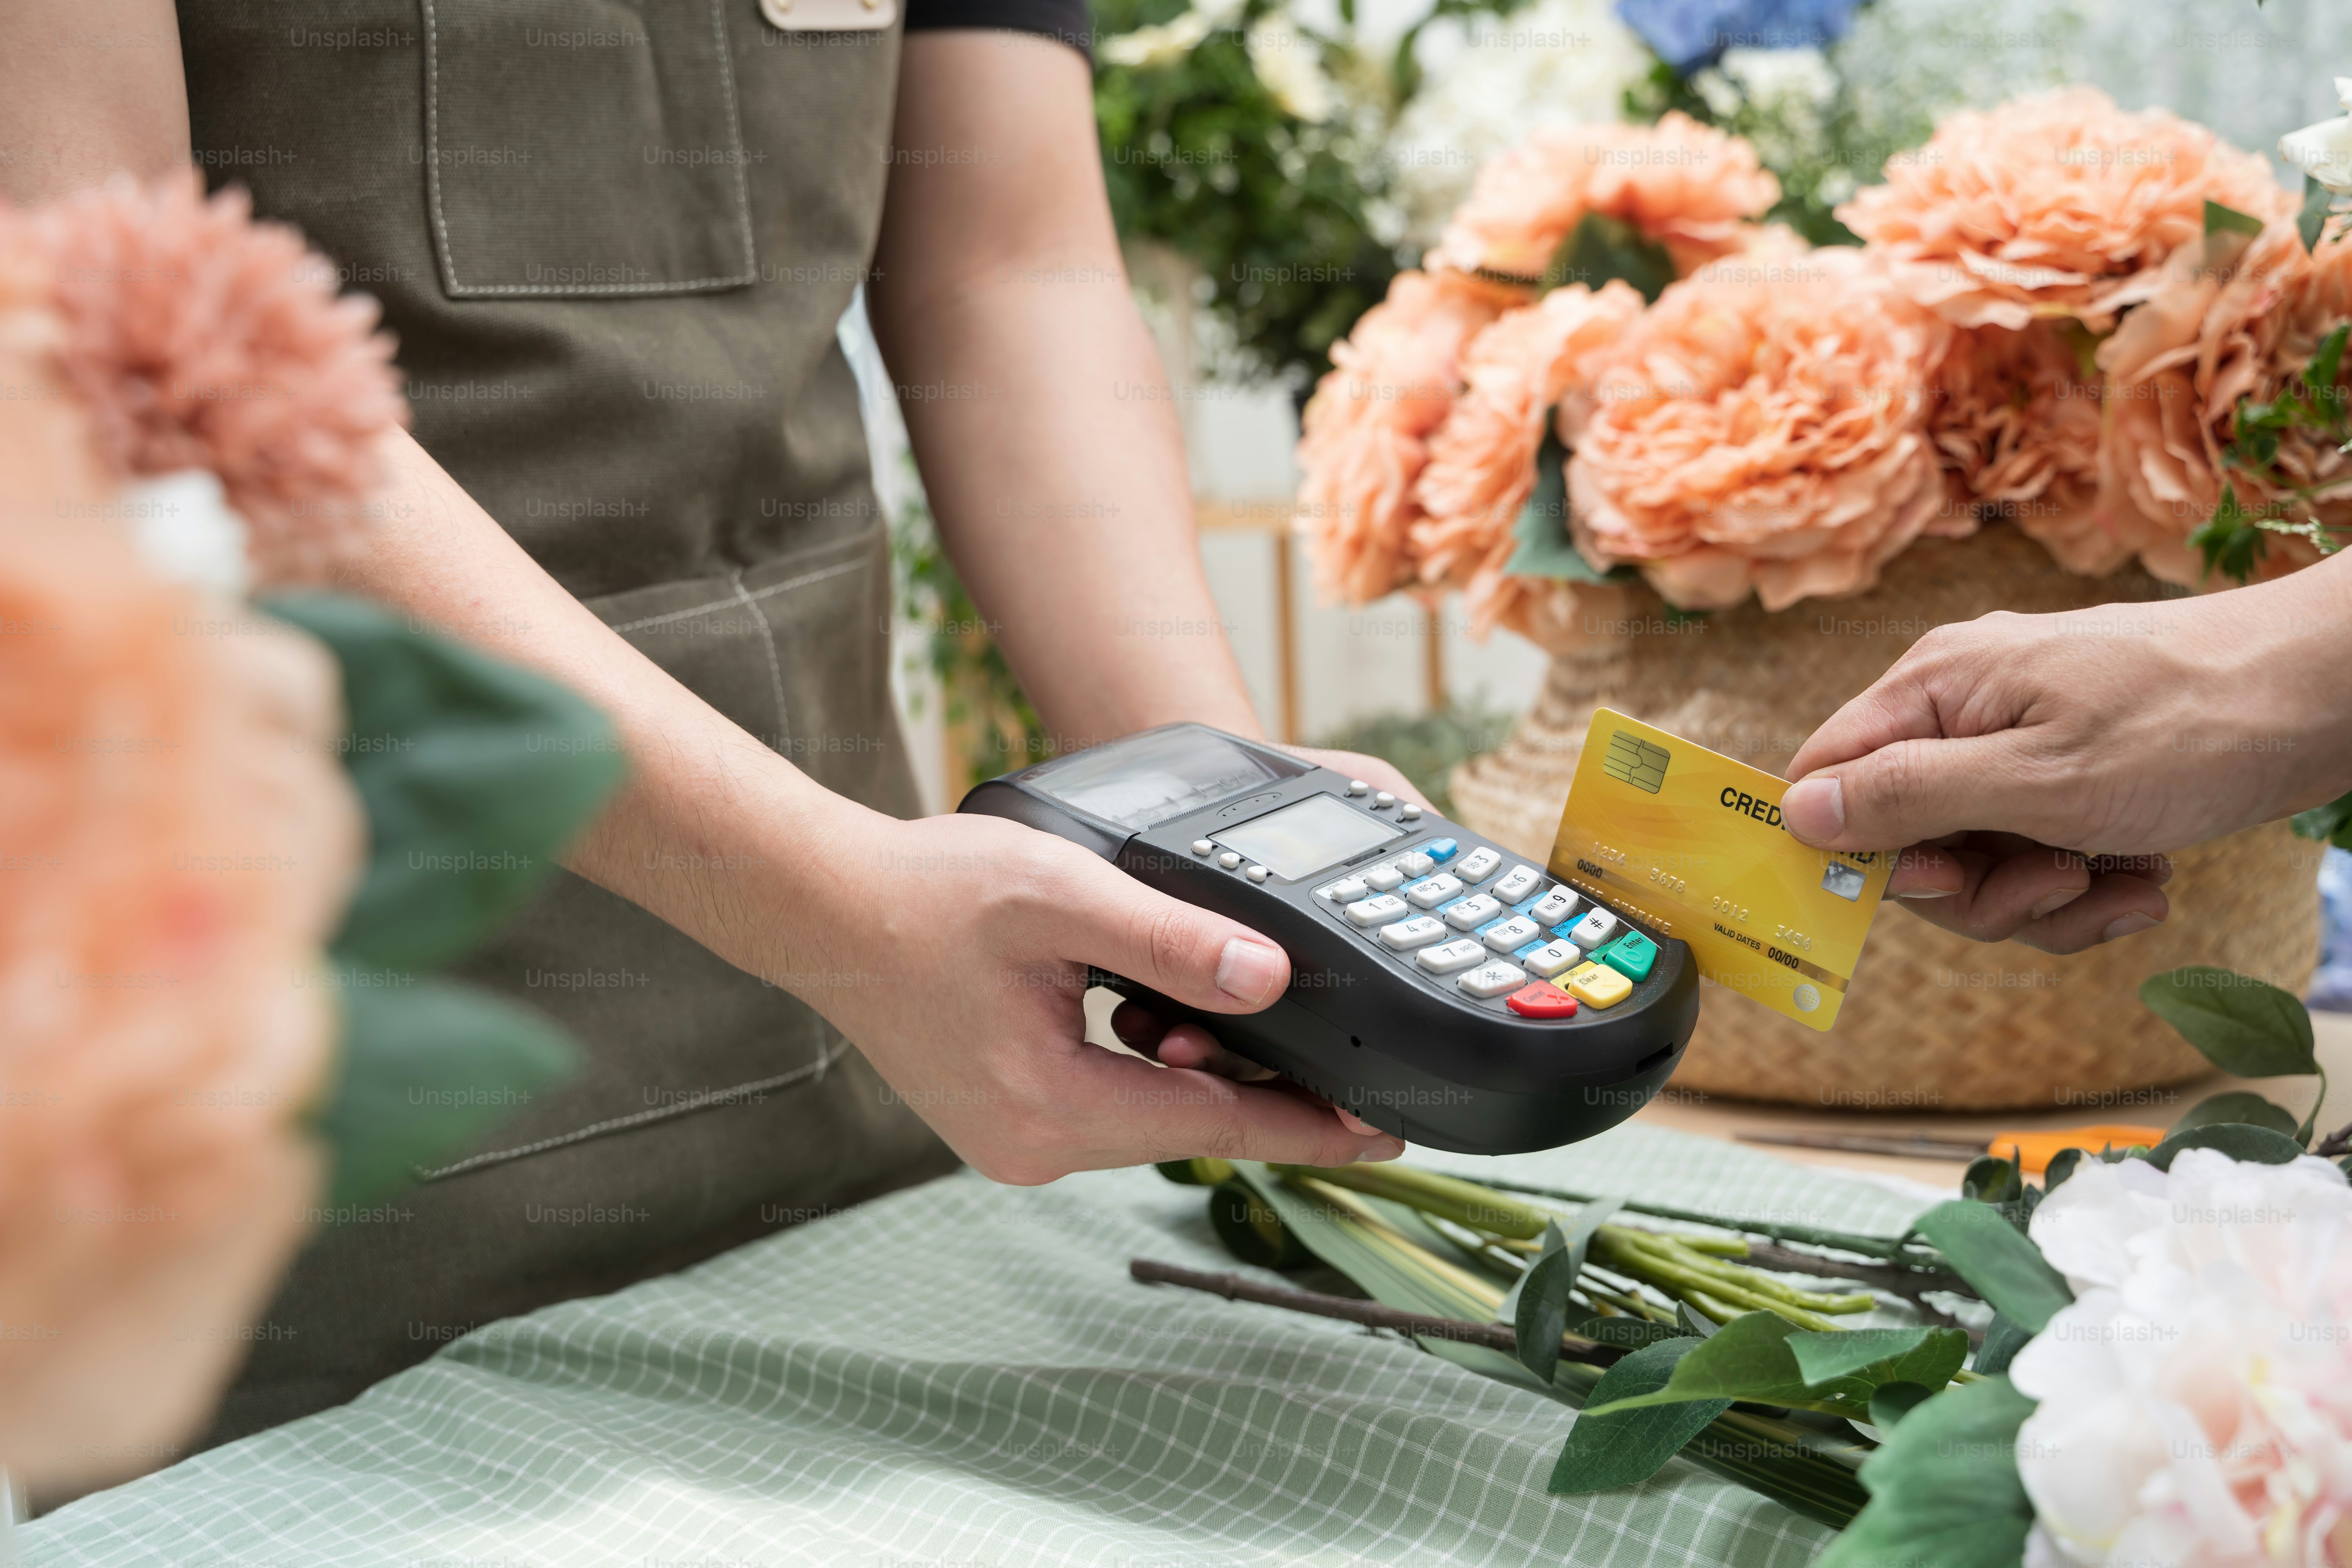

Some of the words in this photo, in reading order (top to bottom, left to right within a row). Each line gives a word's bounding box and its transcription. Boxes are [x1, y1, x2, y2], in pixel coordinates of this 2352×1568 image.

[1720, 787, 1786, 830] CRED
[1474, 855, 1489, 863] 3
[1577, 859, 1602, 878] 0000
[1406, 879, 1423, 887] SETUP
[1592, 842, 1625, 866] 1234
[1650, 868, 1686, 893] 5678
[1713, 896, 1748, 922] 9012
[1775, 924, 1811, 951] 3456
[1443, 899, 1463, 908] TOTALS
[1466, 902, 1481, 910] 5
[1512, 899, 1535, 911] AUTHORIZE
[1543, 902, 1559, 911] WXY
[1553, 895, 1566, 903] 9
[1422, 919, 1436, 928] GHI
[1552, 924, 1569, 934] ALPHA
[1589, 917, 1604, 929] #
[1494, 927, 1509, 936] TUV
[1508, 926, 1523, 934] 8
[1522, 944, 1540, 953] TESTS
[1623, 937, 1644, 949] Enter
[1714, 923, 1735, 938] VALID
[1736, 934, 1760, 950] DATES
[1768, 947, 1799, 969] 00/00
[1442, 947, 1456, 957] 7
[1459, 943, 1477, 953] PRS
[1548, 949, 1562, 957] 0
[1579, 973, 1599, 985] Clear
[1523, 989, 1546, 1002] Cancel
